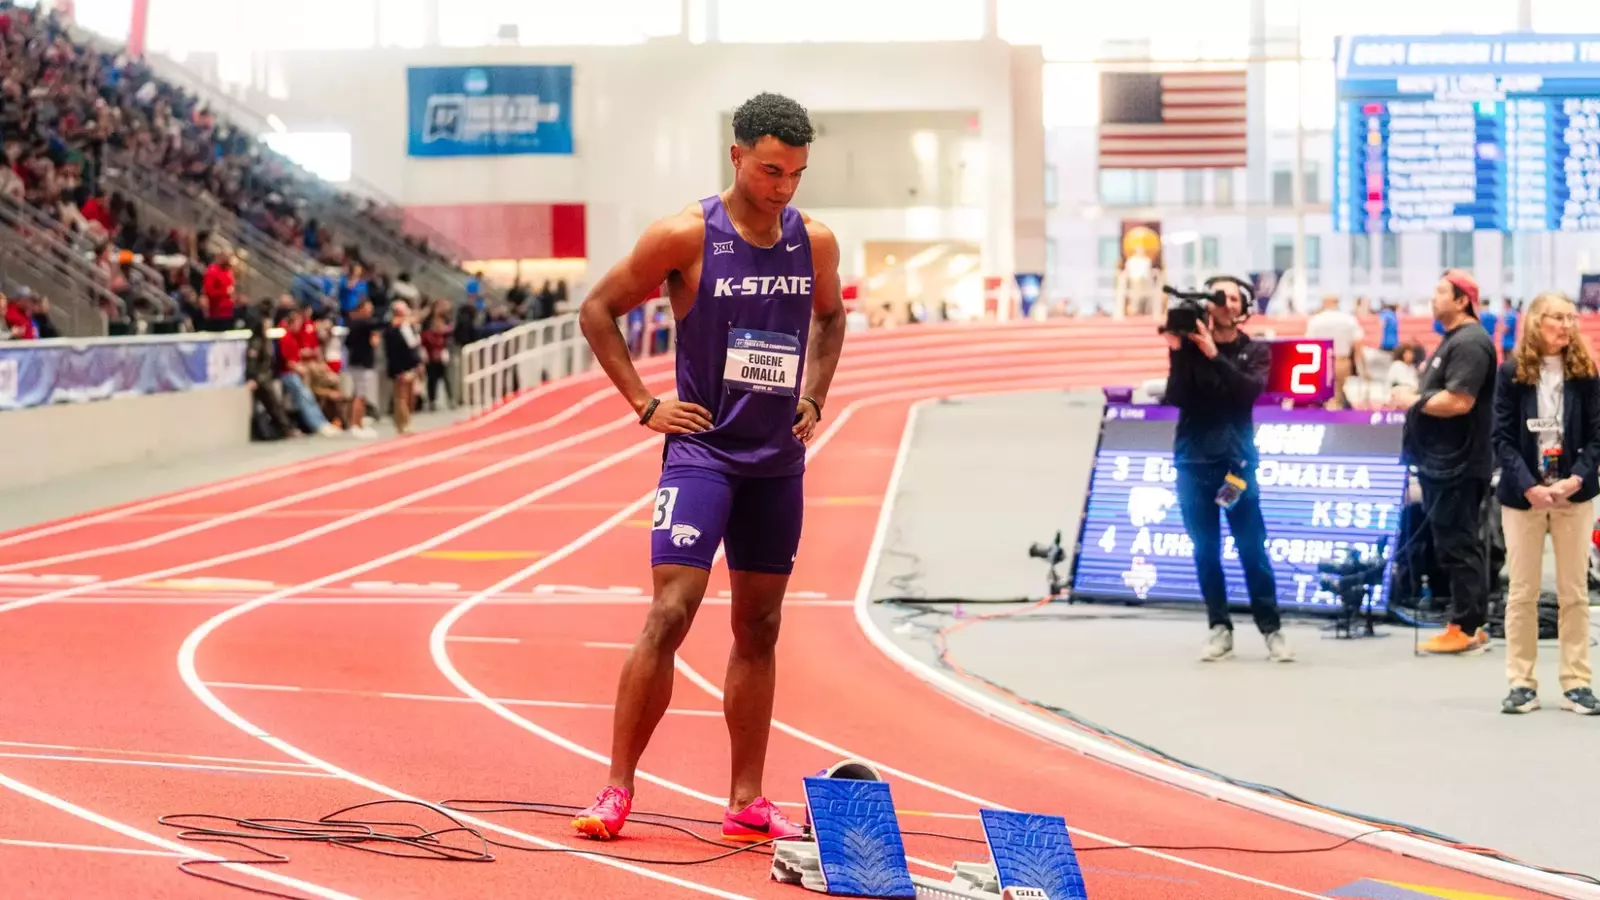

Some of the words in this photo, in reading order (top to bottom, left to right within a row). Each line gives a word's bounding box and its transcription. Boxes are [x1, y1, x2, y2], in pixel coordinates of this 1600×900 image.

[714, 276, 811, 297] K-STATE
[749, 353, 783, 367] EUGENE
[1290, 343, 1321, 394] 2
[741, 366, 785, 383] OMALLA
[1112, 456, 1130, 481] 3
[1256, 461, 1370, 488] OMALLA
[654, 489, 671, 527] 3
[1311, 500, 1396, 529] KSST
[1098, 524, 1116, 552] 4
[1016, 889, 1043, 897] GILL
